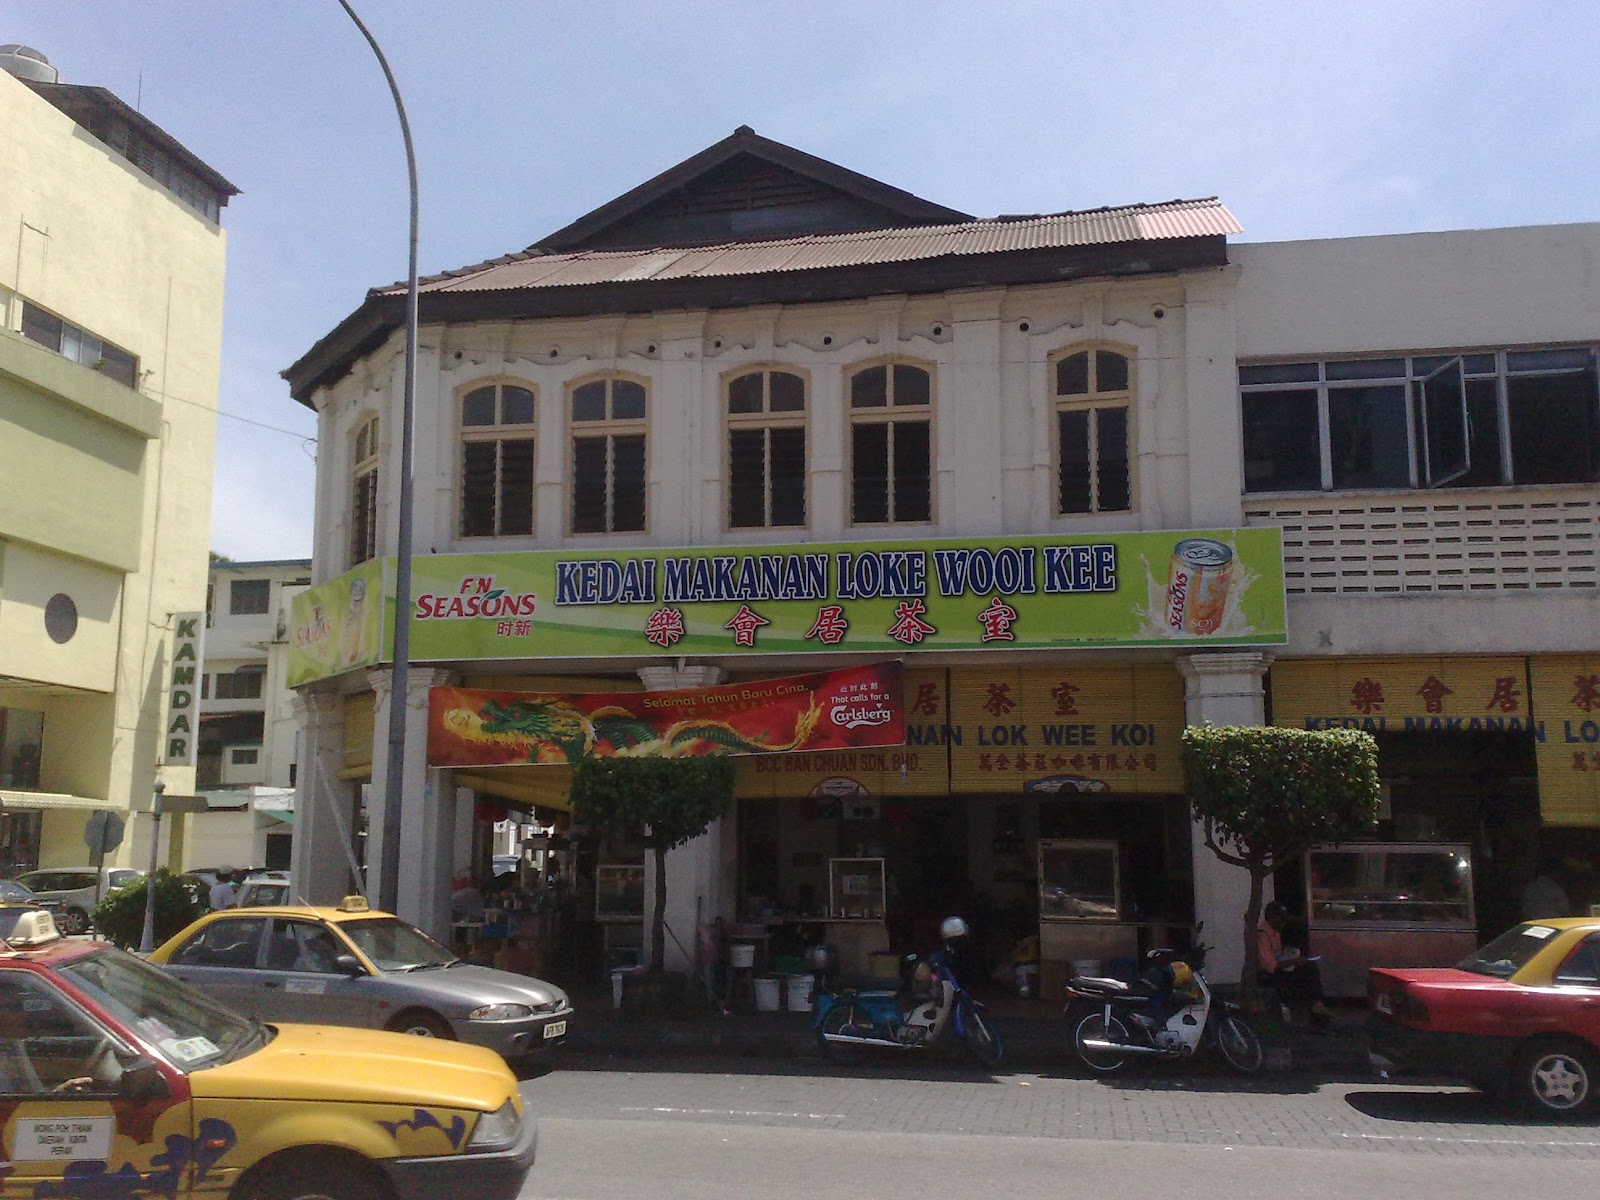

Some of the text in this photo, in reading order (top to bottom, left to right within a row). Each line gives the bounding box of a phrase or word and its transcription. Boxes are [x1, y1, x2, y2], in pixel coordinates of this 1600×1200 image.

[556, 545, 1116, 605] KEDAI MAKANAN LOKE WOOI KEE
[416, 594, 536, 619] SEASONS
[1169, 570, 1188, 630] SEASONS
[496, 619, 532, 637] 时新
[168, 618, 198, 758] KAMDAR
[643, 698, 697, 709] Selamat
[702, 693, 738, 706] Tahun
[742, 688, 773, 701] Baru
[830, 696, 849, 704] That
[850, 693, 869, 703] calls
[870, 692, 882, 701] for
[830, 702, 891, 730] Carlsberg
[977, 724, 1029, 746] LOK
[1041, 724, 1096, 746] WEE
[1111, 724, 1156, 746] KOI
[815, 754, 857, 772] CHUAN
